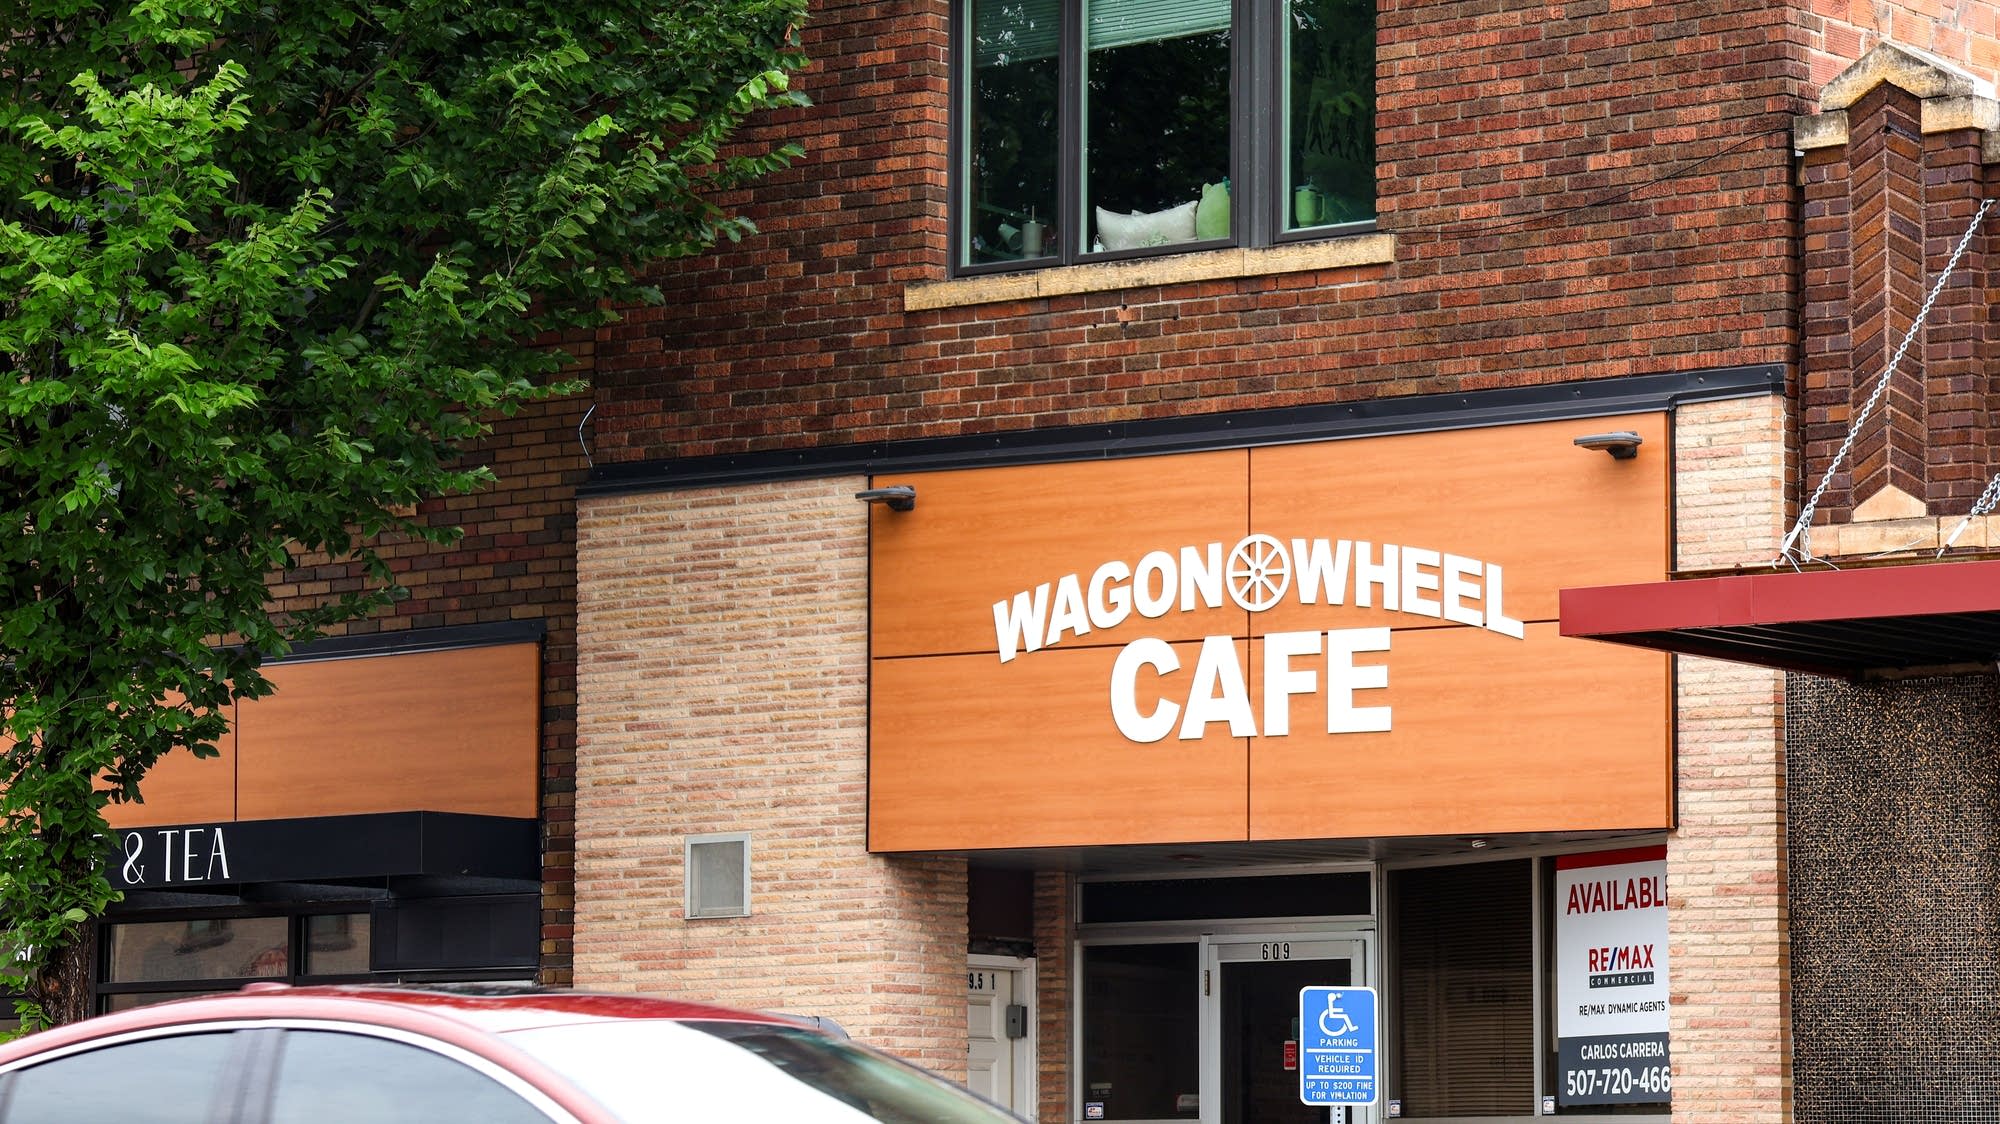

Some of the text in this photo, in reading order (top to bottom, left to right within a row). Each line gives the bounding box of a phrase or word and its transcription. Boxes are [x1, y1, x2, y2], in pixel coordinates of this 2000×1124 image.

[991, 538, 1525, 664] WAGON WHEEL
[1110, 626, 1392, 743] CAFE
[122, 832, 145, 885] &
[158, 827, 230, 883] TEA
[1566, 874, 1668, 916] AVAILABL
[1262, 942, 1290, 960] 609
[1588, 943, 1654, 973] RE/MAX
[967, 972, 995, 990] 9.5 1
[1590, 974, 1653, 986] COMMERCIAL
[1578, 1000, 1666, 1017] RE/MAX DYNAMIC AGENTS
[1319, 1038, 1358, 1047] PARKING
[1580, 1041, 1665, 1060] CARLOS CARRERA
[1314, 1055, 1364, 1063] VEHICLE ID
[1318, 1065, 1361, 1073] REQUIRED
[1306, 1081, 1373, 1090] UP TO $200 FINE
[1311, 1091, 1326, 1100] FOR
